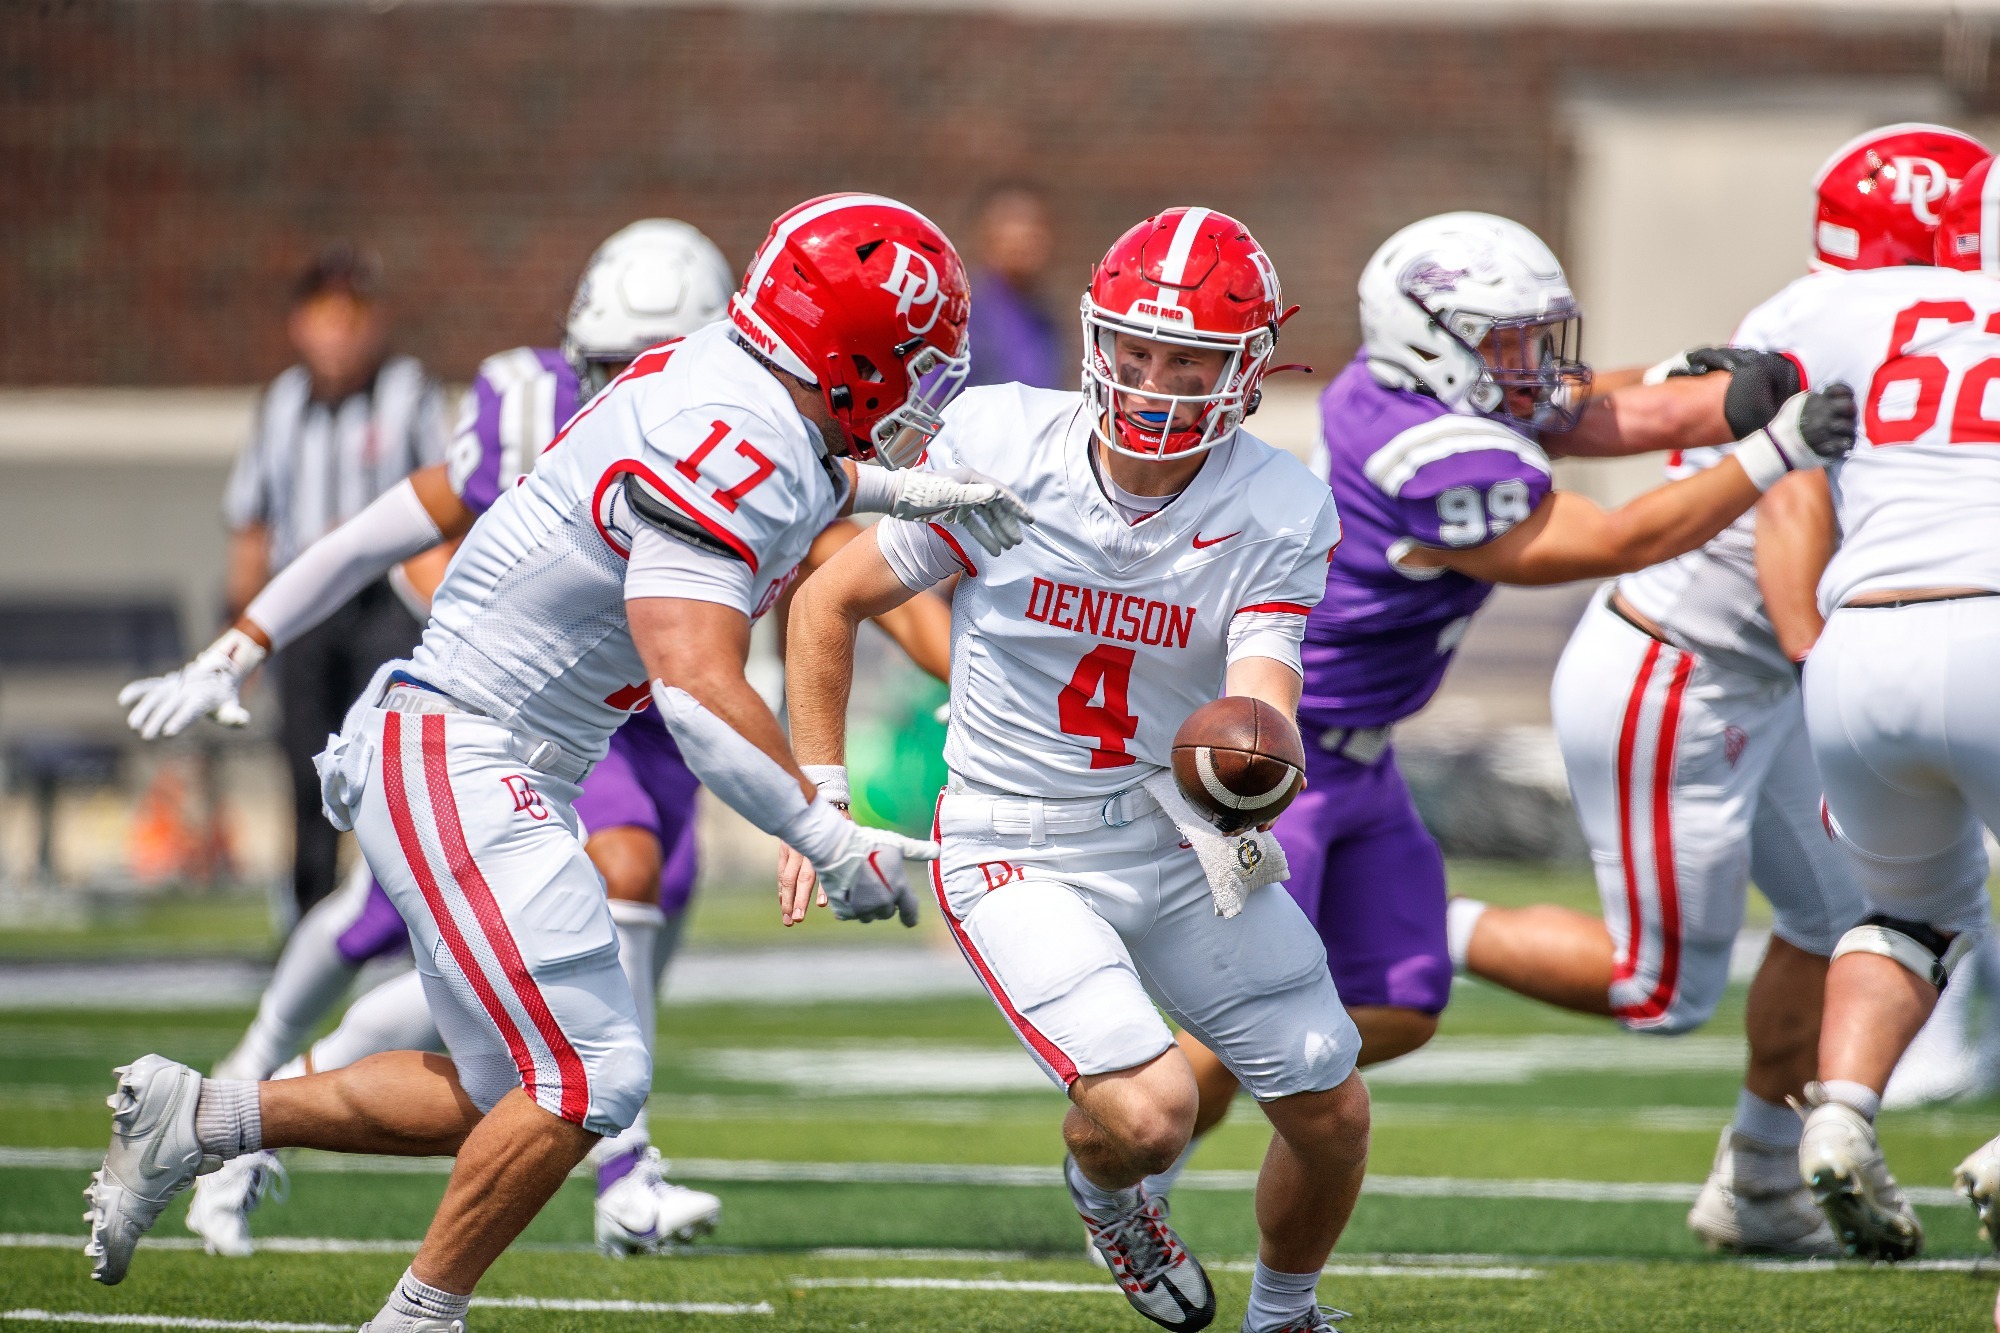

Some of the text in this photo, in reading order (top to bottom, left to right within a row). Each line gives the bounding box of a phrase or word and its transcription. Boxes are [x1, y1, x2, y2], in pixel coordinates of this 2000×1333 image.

[879, 241, 949, 335] DU
[1137, 302, 1184, 320] BIG RED
[675, 420, 777, 514] 17
[1436, 477, 1531, 547] 99
[1024, 576, 1197, 649] DENISON
[1057, 643, 1139, 770] 4
